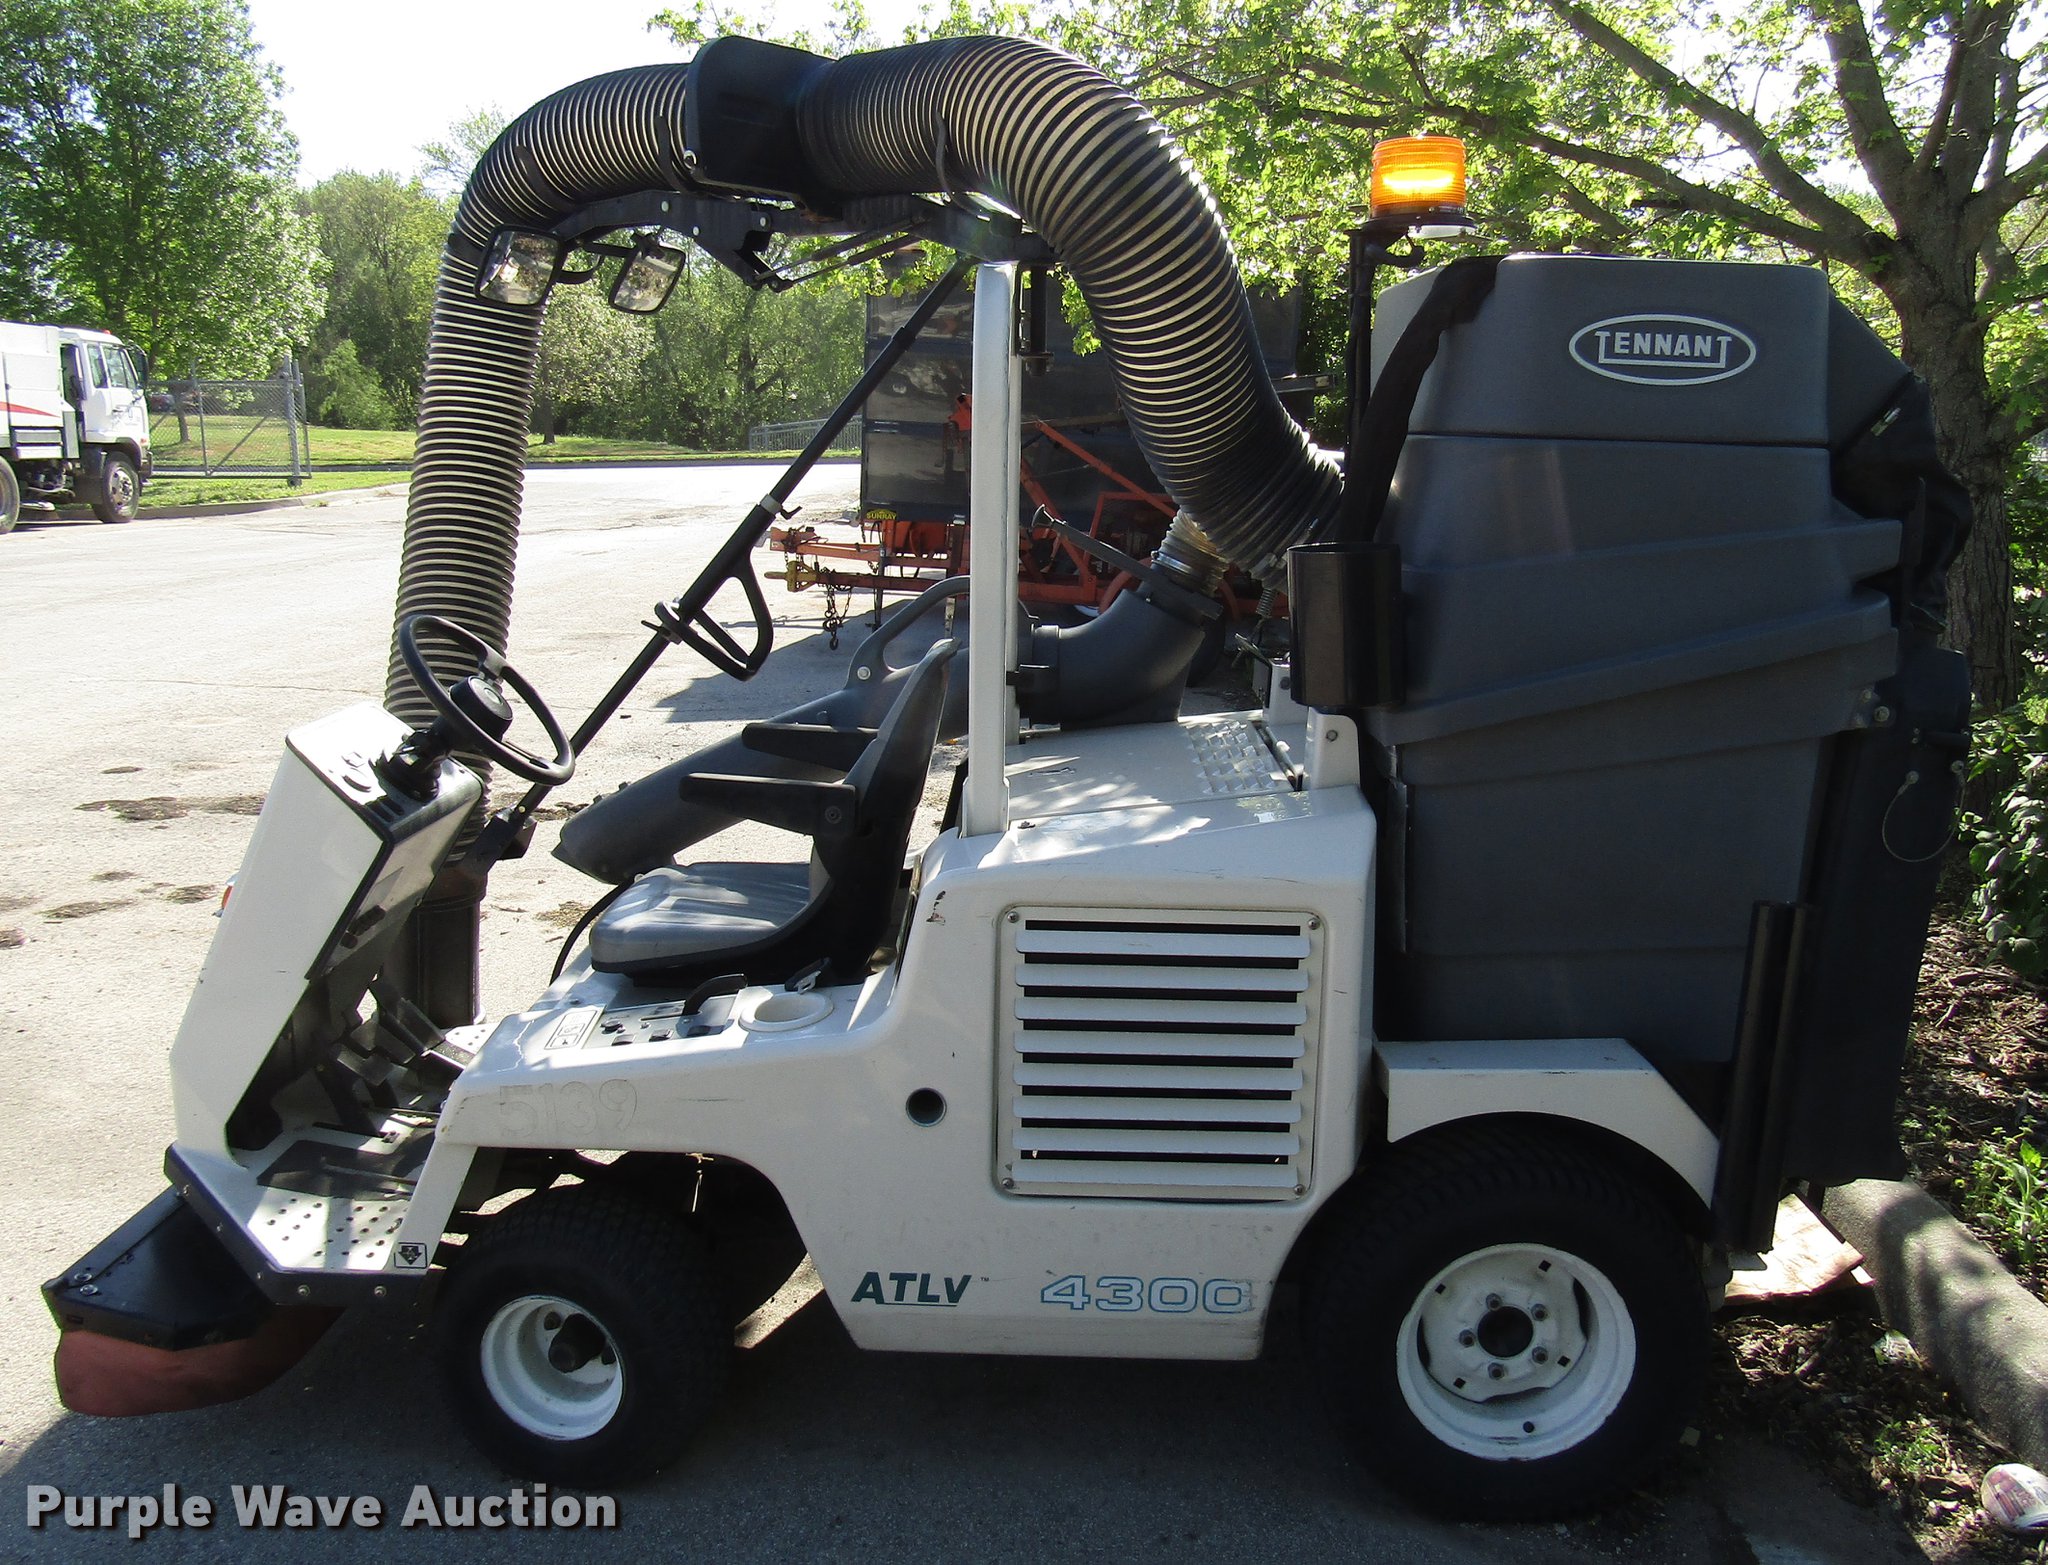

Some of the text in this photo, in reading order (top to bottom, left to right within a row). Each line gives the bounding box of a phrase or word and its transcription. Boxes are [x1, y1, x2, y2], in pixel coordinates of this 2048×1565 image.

[1595, 331, 1732, 368] TENNANT
[866, 512, 897, 520] SUNRAY
[499, 1079, 638, 1138] 5139
[850, 1271, 973, 1307] ATLV
[1038, 1275, 1253, 1314] 4300
